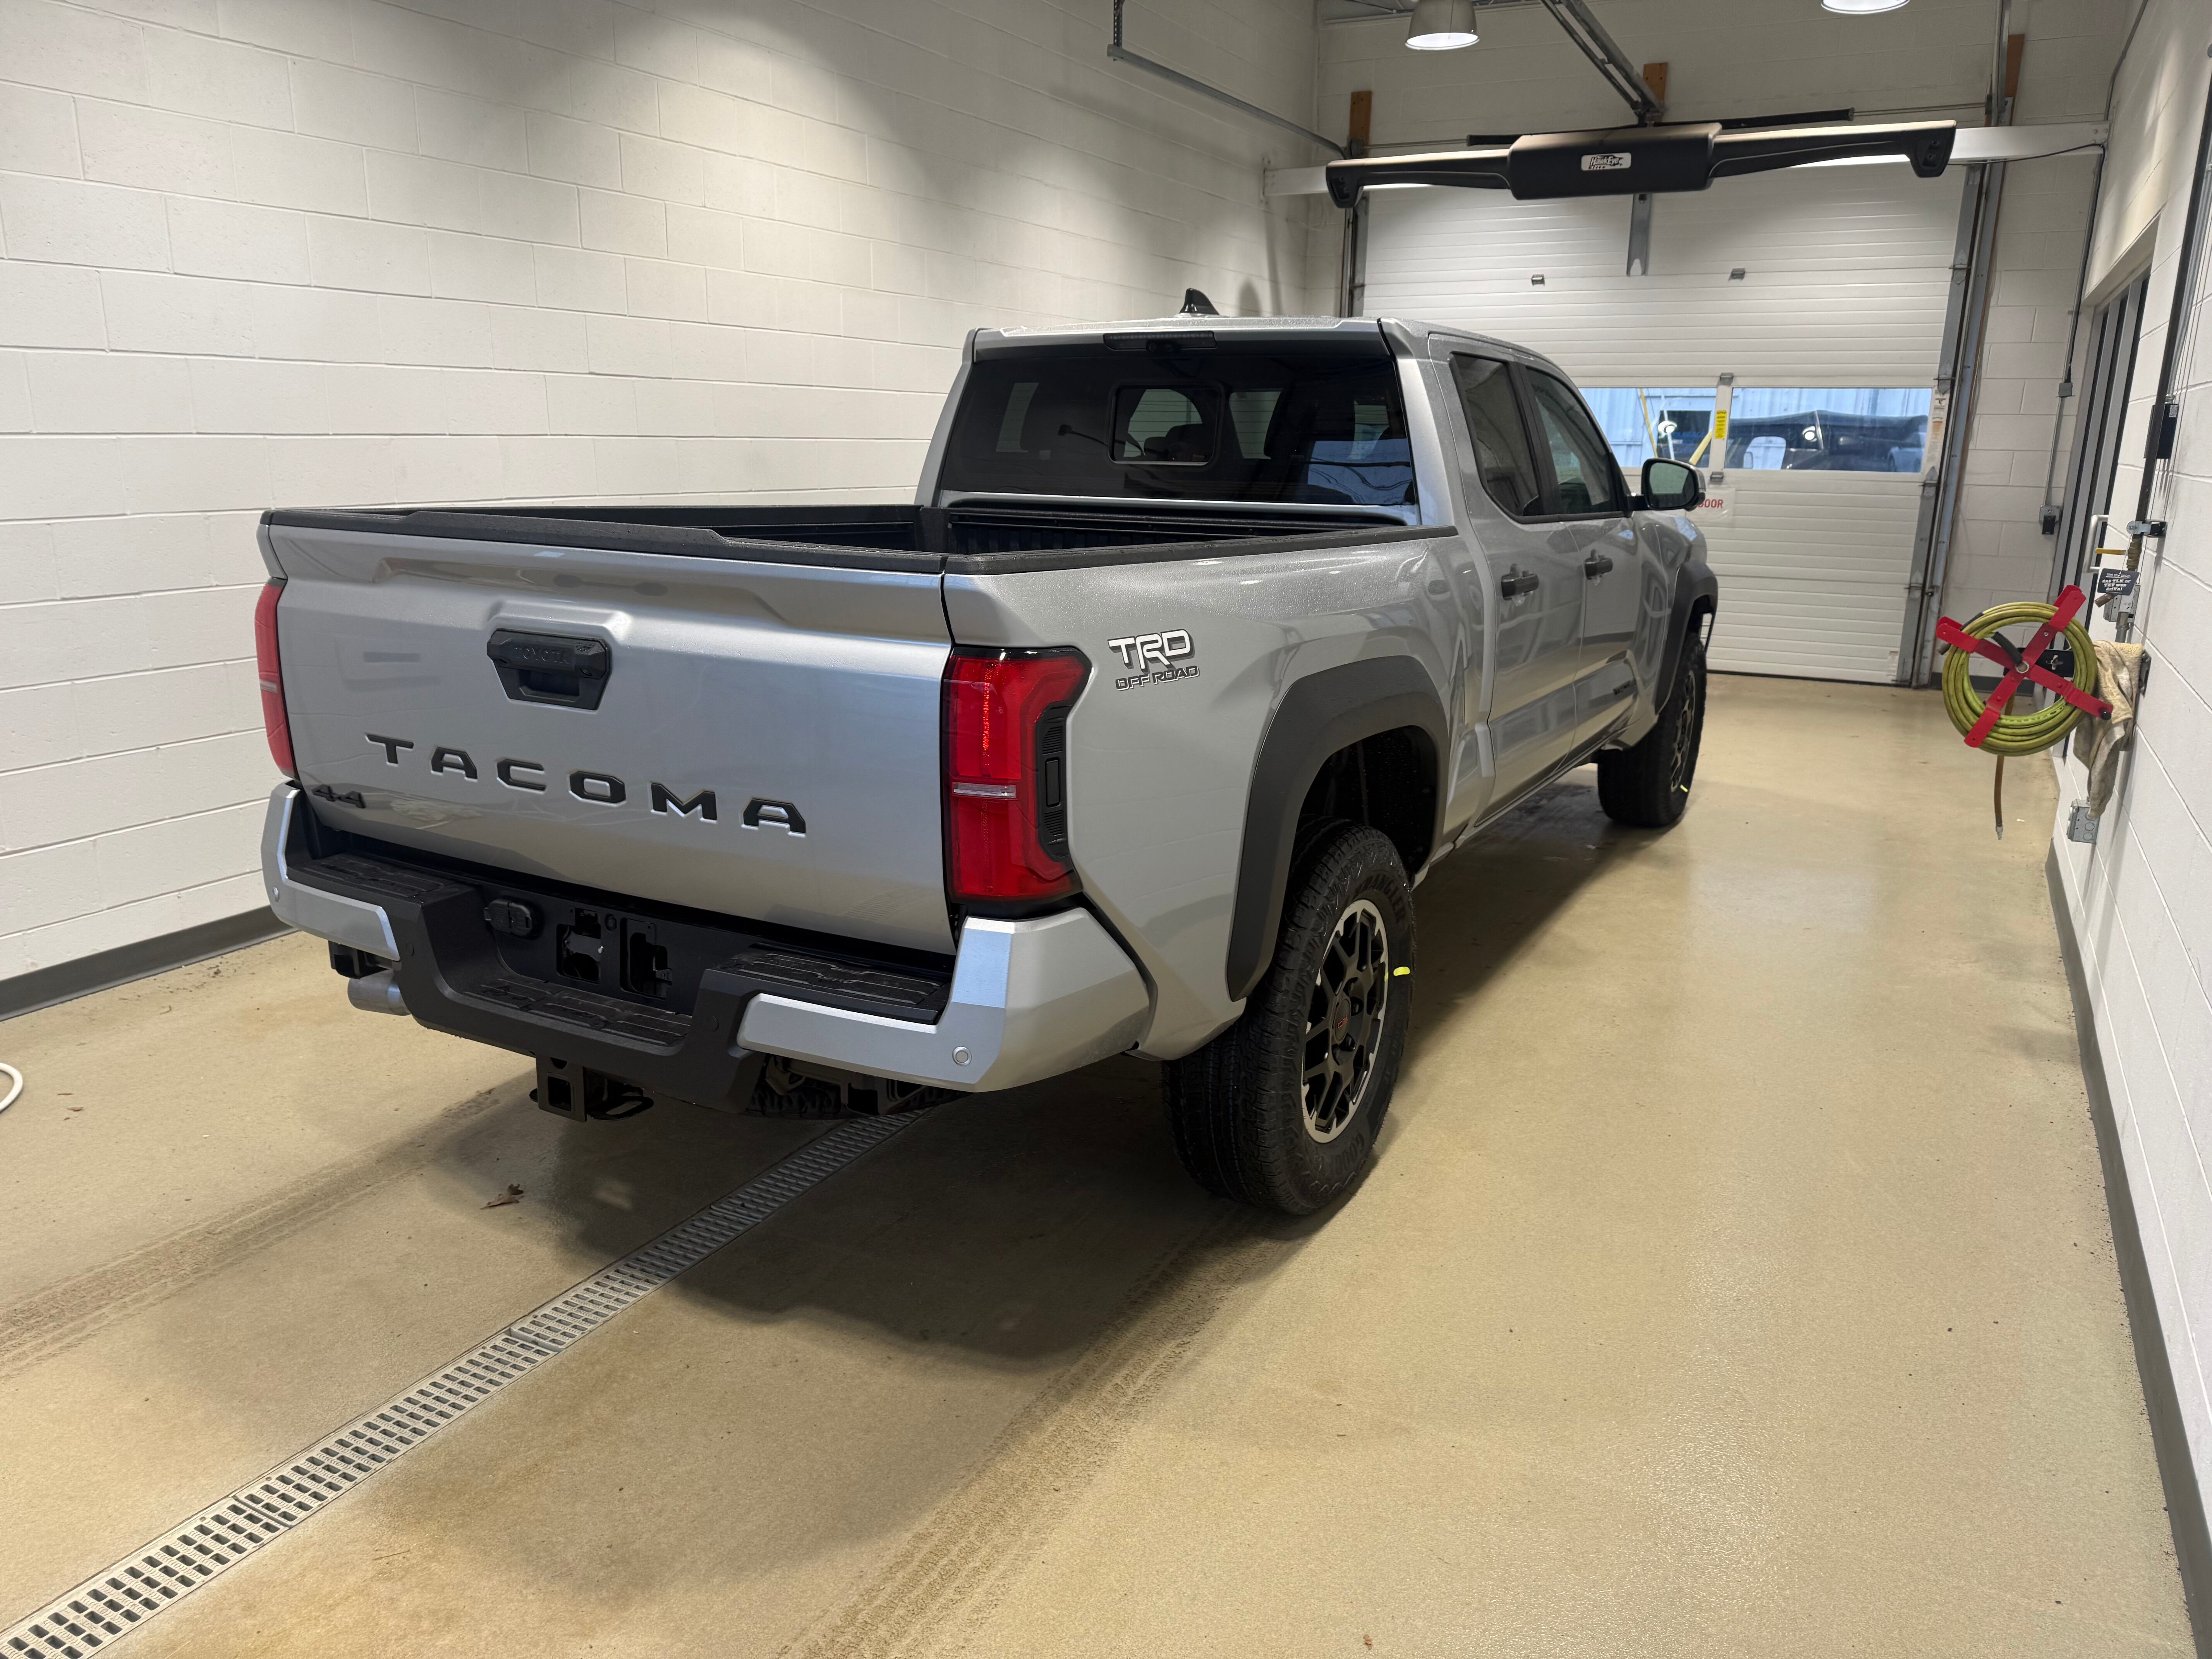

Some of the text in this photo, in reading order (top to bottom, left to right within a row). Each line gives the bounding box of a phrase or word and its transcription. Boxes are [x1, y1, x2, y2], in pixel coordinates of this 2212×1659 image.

[515, 646, 570, 664] TOYOTA
[1108, 629, 1195, 674] TRD
[1115, 665, 1200, 691] OFF ROAD
[365, 733, 806, 837] TACOMA
